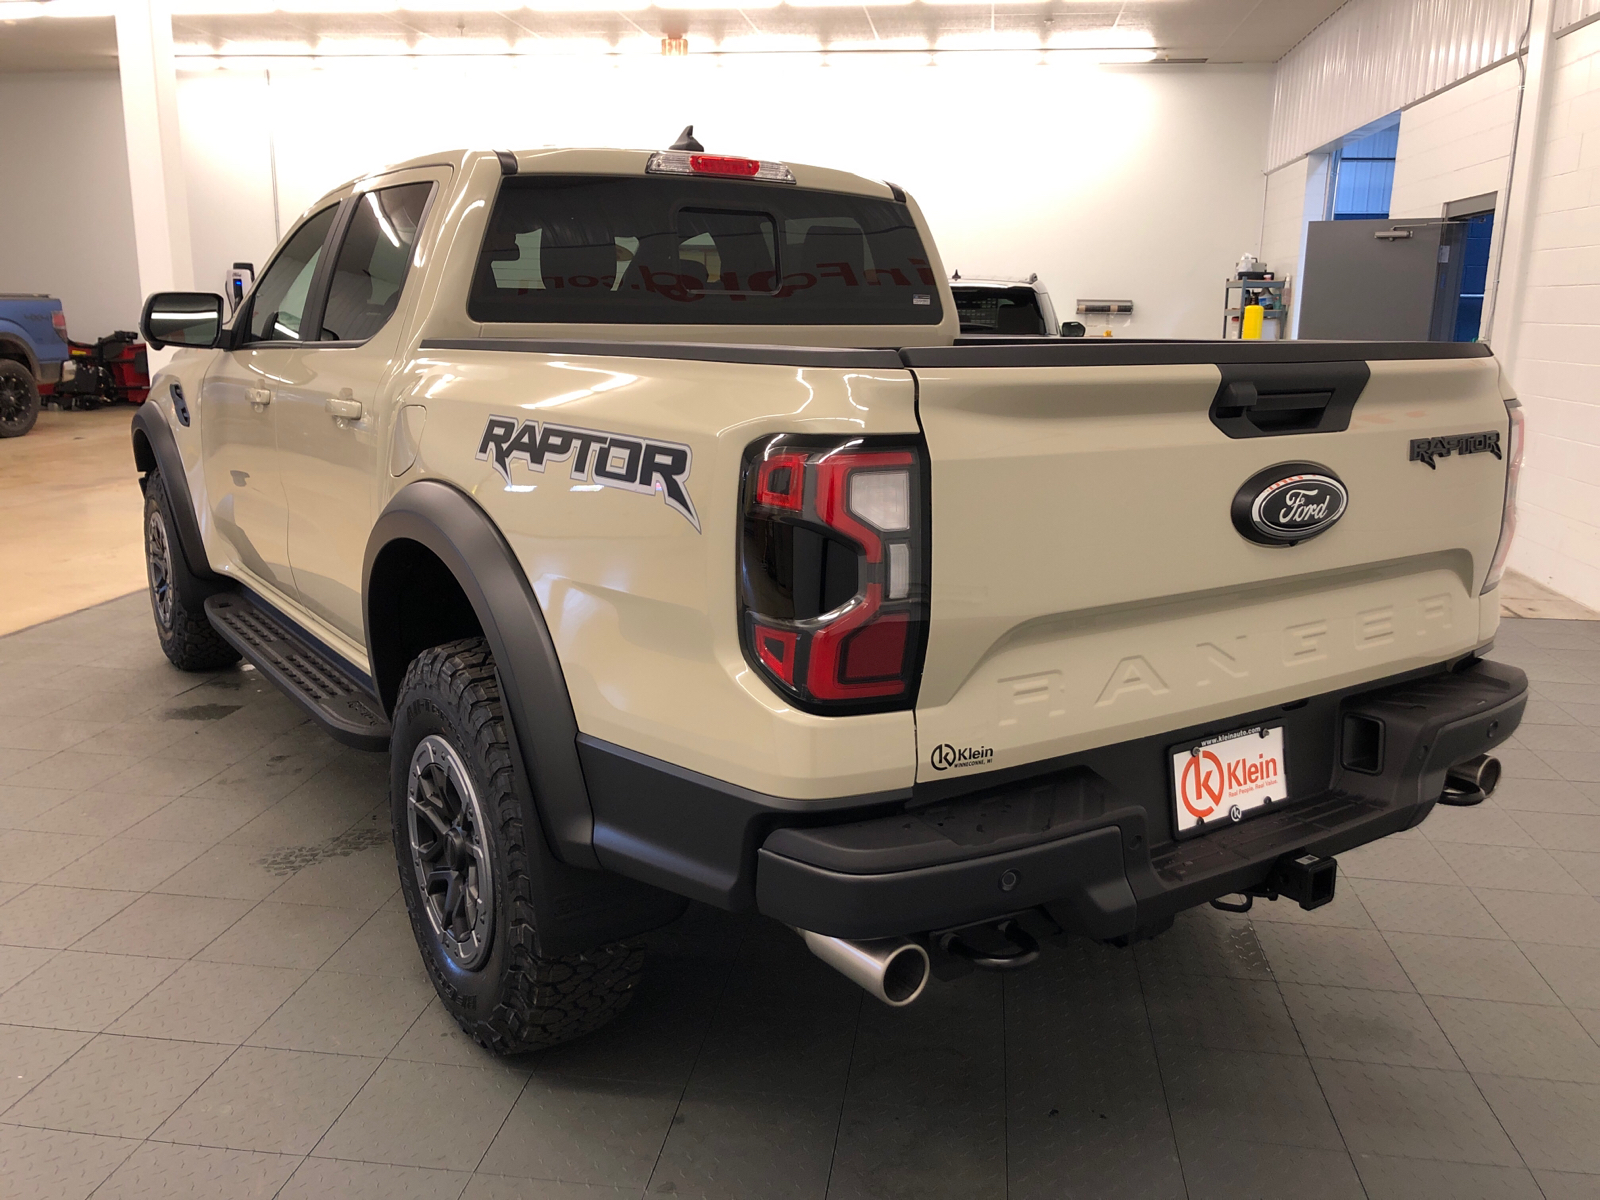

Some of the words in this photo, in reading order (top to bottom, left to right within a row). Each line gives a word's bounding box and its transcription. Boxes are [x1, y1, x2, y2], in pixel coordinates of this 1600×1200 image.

[1409, 430, 1502, 470] RAPTOR
[475, 414, 702, 535] RAPTOR
[1279, 489, 1330, 523] Ford
[997, 592, 1453, 726] RANGER
[958, 745, 994, 761] Klein
[1201, 726, 1261, 746] www.kleinauto.com
[1226, 752, 1278, 790] Klein
